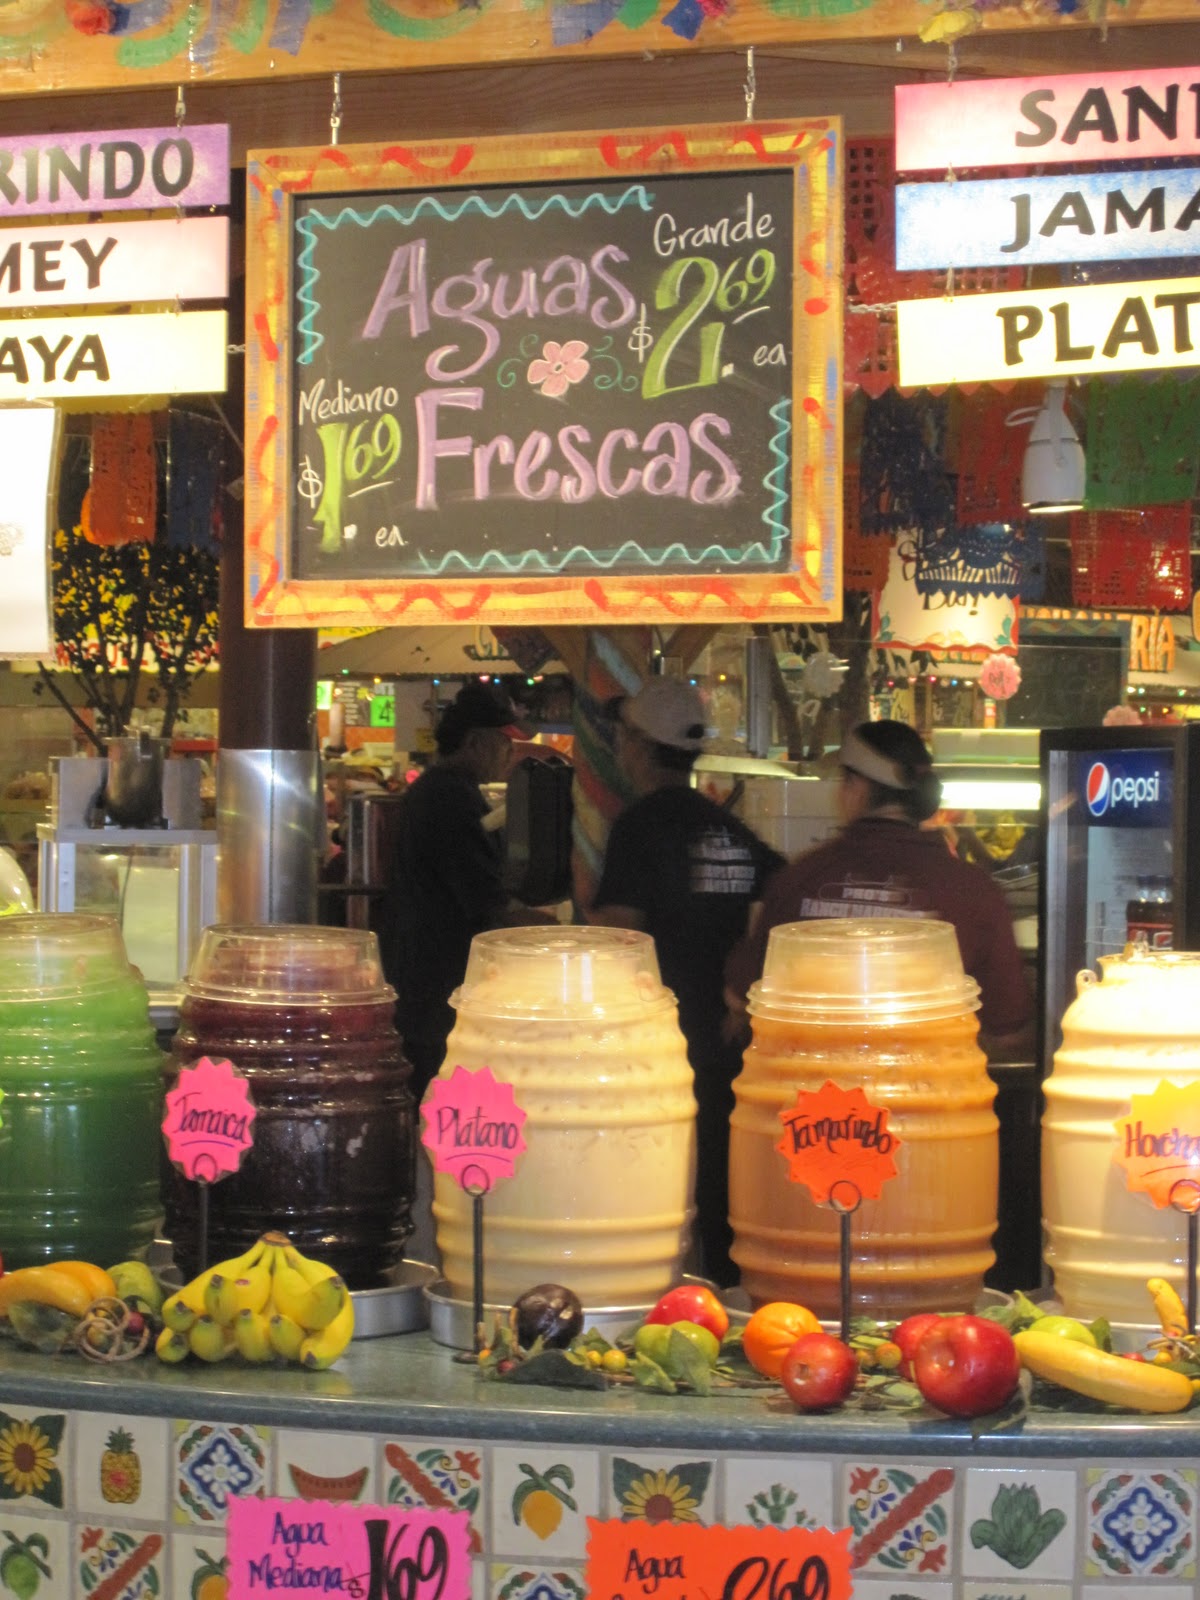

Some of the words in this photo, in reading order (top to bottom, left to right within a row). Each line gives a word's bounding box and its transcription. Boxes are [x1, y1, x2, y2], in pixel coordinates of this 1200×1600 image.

[653, 192, 776, 256] Grande
[361, 238, 636, 382] Aguas
[996, 292, 1200, 366] PLAT
[0, 333, 110, 384] AYA
[752, 343, 788, 366] ea
[297, 378, 400, 426] Mediano
[414, 386, 743, 512] Frescas
[1110, 770, 1161, 809] pepsi
[436, 1105, 520, 1150] Platano
[783, 1111, 892, 1155] Tamarindo
[272, 1511, 331, 1559] Agua
[624, 1548, 686, 1593] Agua
